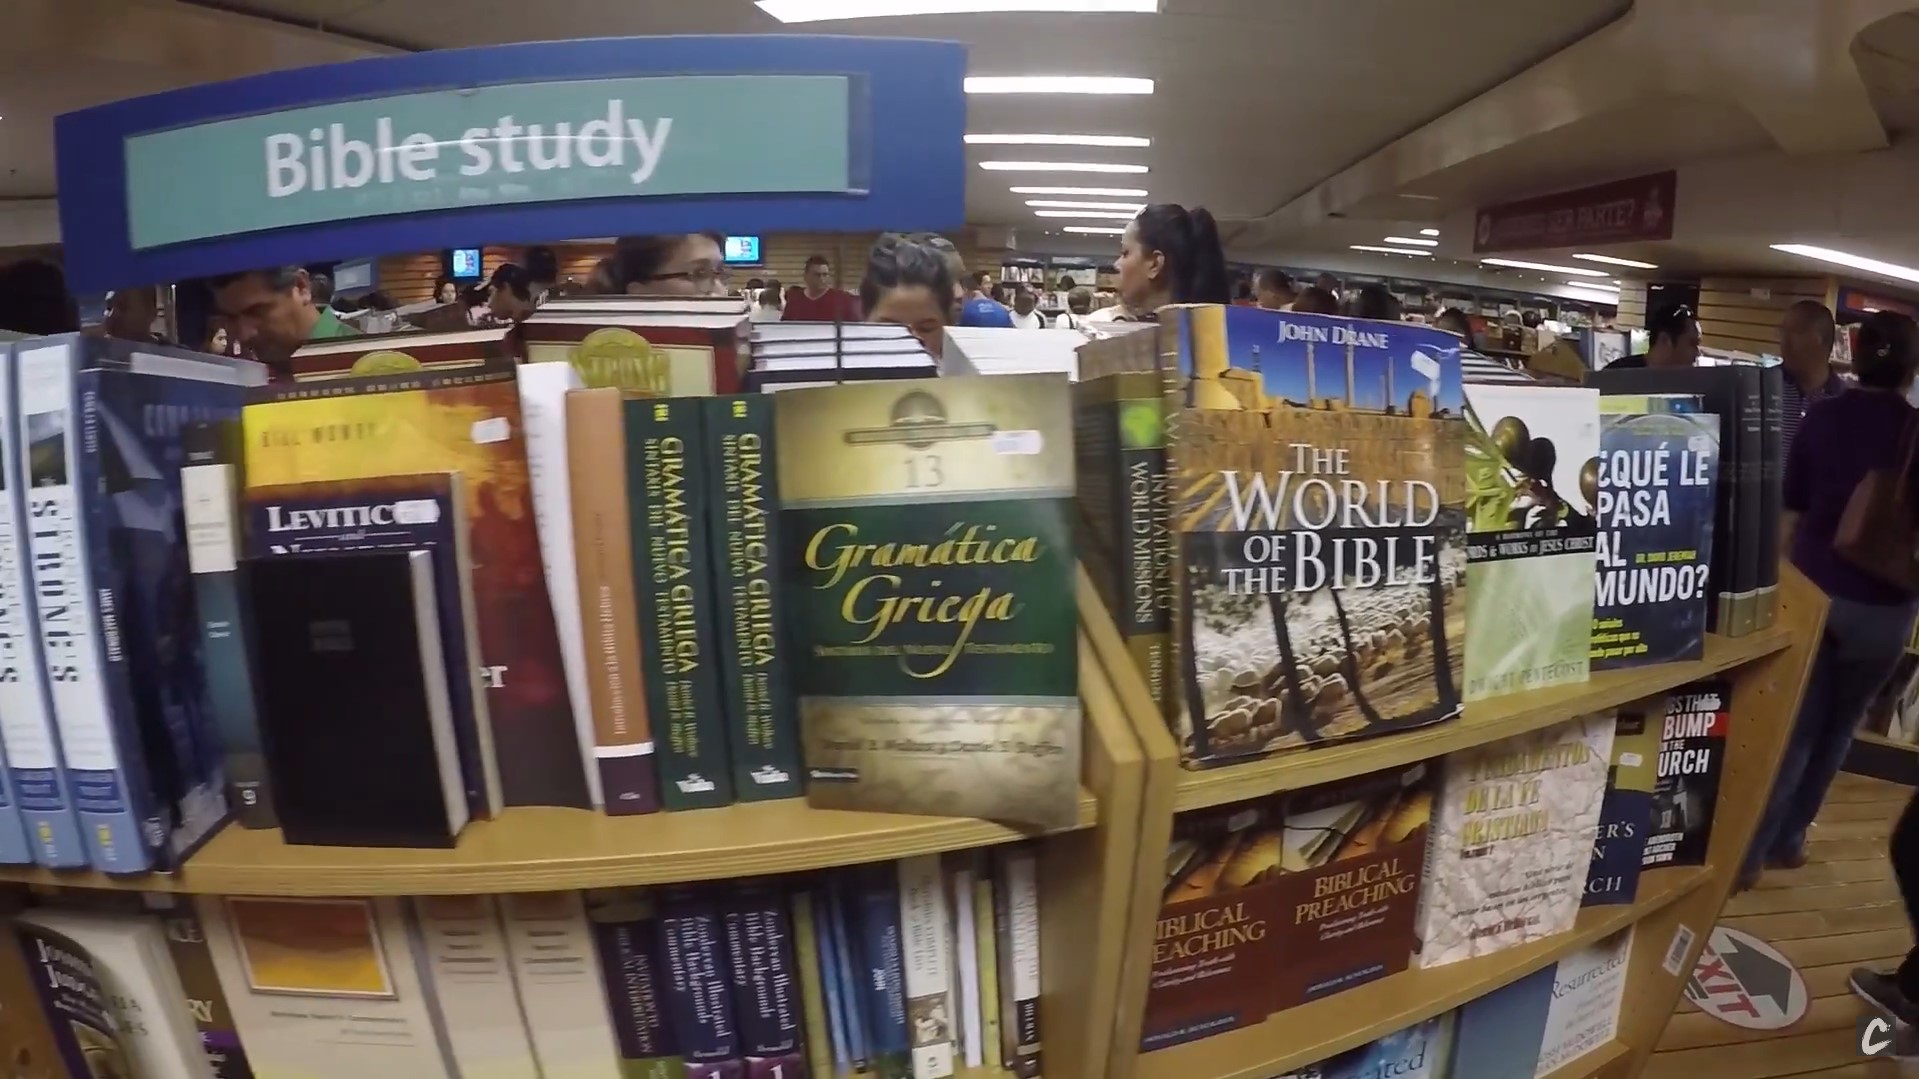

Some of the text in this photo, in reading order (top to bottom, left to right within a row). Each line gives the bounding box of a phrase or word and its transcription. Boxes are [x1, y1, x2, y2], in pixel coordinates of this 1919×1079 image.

[265, 99, 672, 198] Bible study
[1277, 321, 1328, 343] JOHN
[904, 455, 944, 489] 13
[1289, 443, 1350, 475] THE
[1598, 441, 1710, 489] ¿QUÉ LE
[266, 504, 397, 532] LEVITIC
[1220, 470, 1440, 531] WORLD
[1596, 490, 1671, 528] PASA
[651, 536, 668, 583] NUEVO
[660, 437, 699, 673] GRAMÁTICA GRIEGA
[728, 531, 746, 577] NUEVO
[738, 433, 775, 666] GRAMÁTICA GRIEGA
[804, 521, 1047, 590] Gramática
[1130, 460, 1153, 625] WORLD MISSIONS
[1222, 531, 1436, 595] THE BIBLE
[1243, 535, 1287, 563] OF
[1595, 531, 1627, 567] AL
[1595, 564, 1709, 607] MUNDO?
[840, 574, 1025, 680] Griega
[1662, 712, 1716, 741] BUMP
[1657, 749, 1710, 777] URCH
[1595, 820, 1635, 840] ER'S
[1294, 874, 1416, 925] PREACHING
[1313, 858, 1403, 898] BIBLICAL
[1152, 920, 1267, 964] EACHING
[1156, 902, 1250, 940] IBLICAL
[1696, 944, 1761, 1018] XIT
